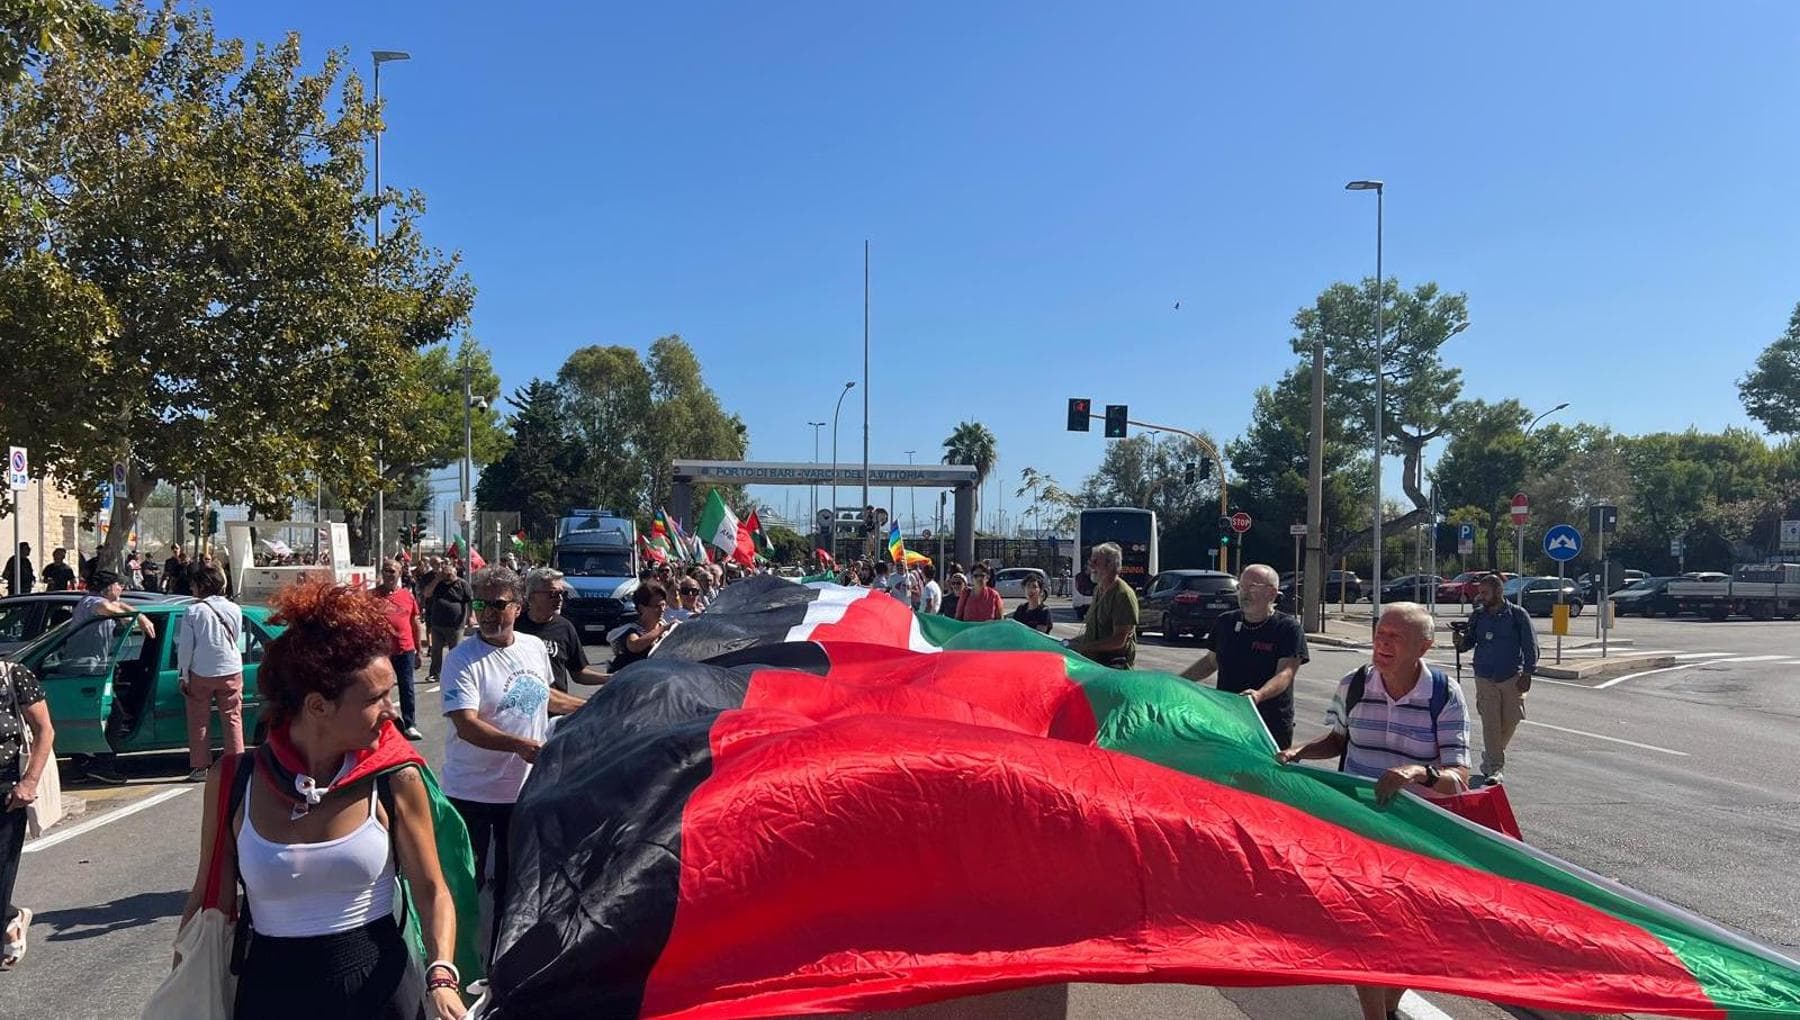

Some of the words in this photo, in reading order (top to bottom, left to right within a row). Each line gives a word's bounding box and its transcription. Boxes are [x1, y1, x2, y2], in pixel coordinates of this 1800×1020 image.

[716, 467, 754, 477] PORTO
[756, 468, 768, 477] DI
[769, 468, 796, 478] BARI
[803, 469, 840, 479] VARCO
[844, 470, 879, 479] DELA
[879, 470, 925, 480] VITTORIA
[1232, 518, 1250, 526] STOP
[1461, 525, 1470, 538] P
[512, 669, 525, 677] THE
